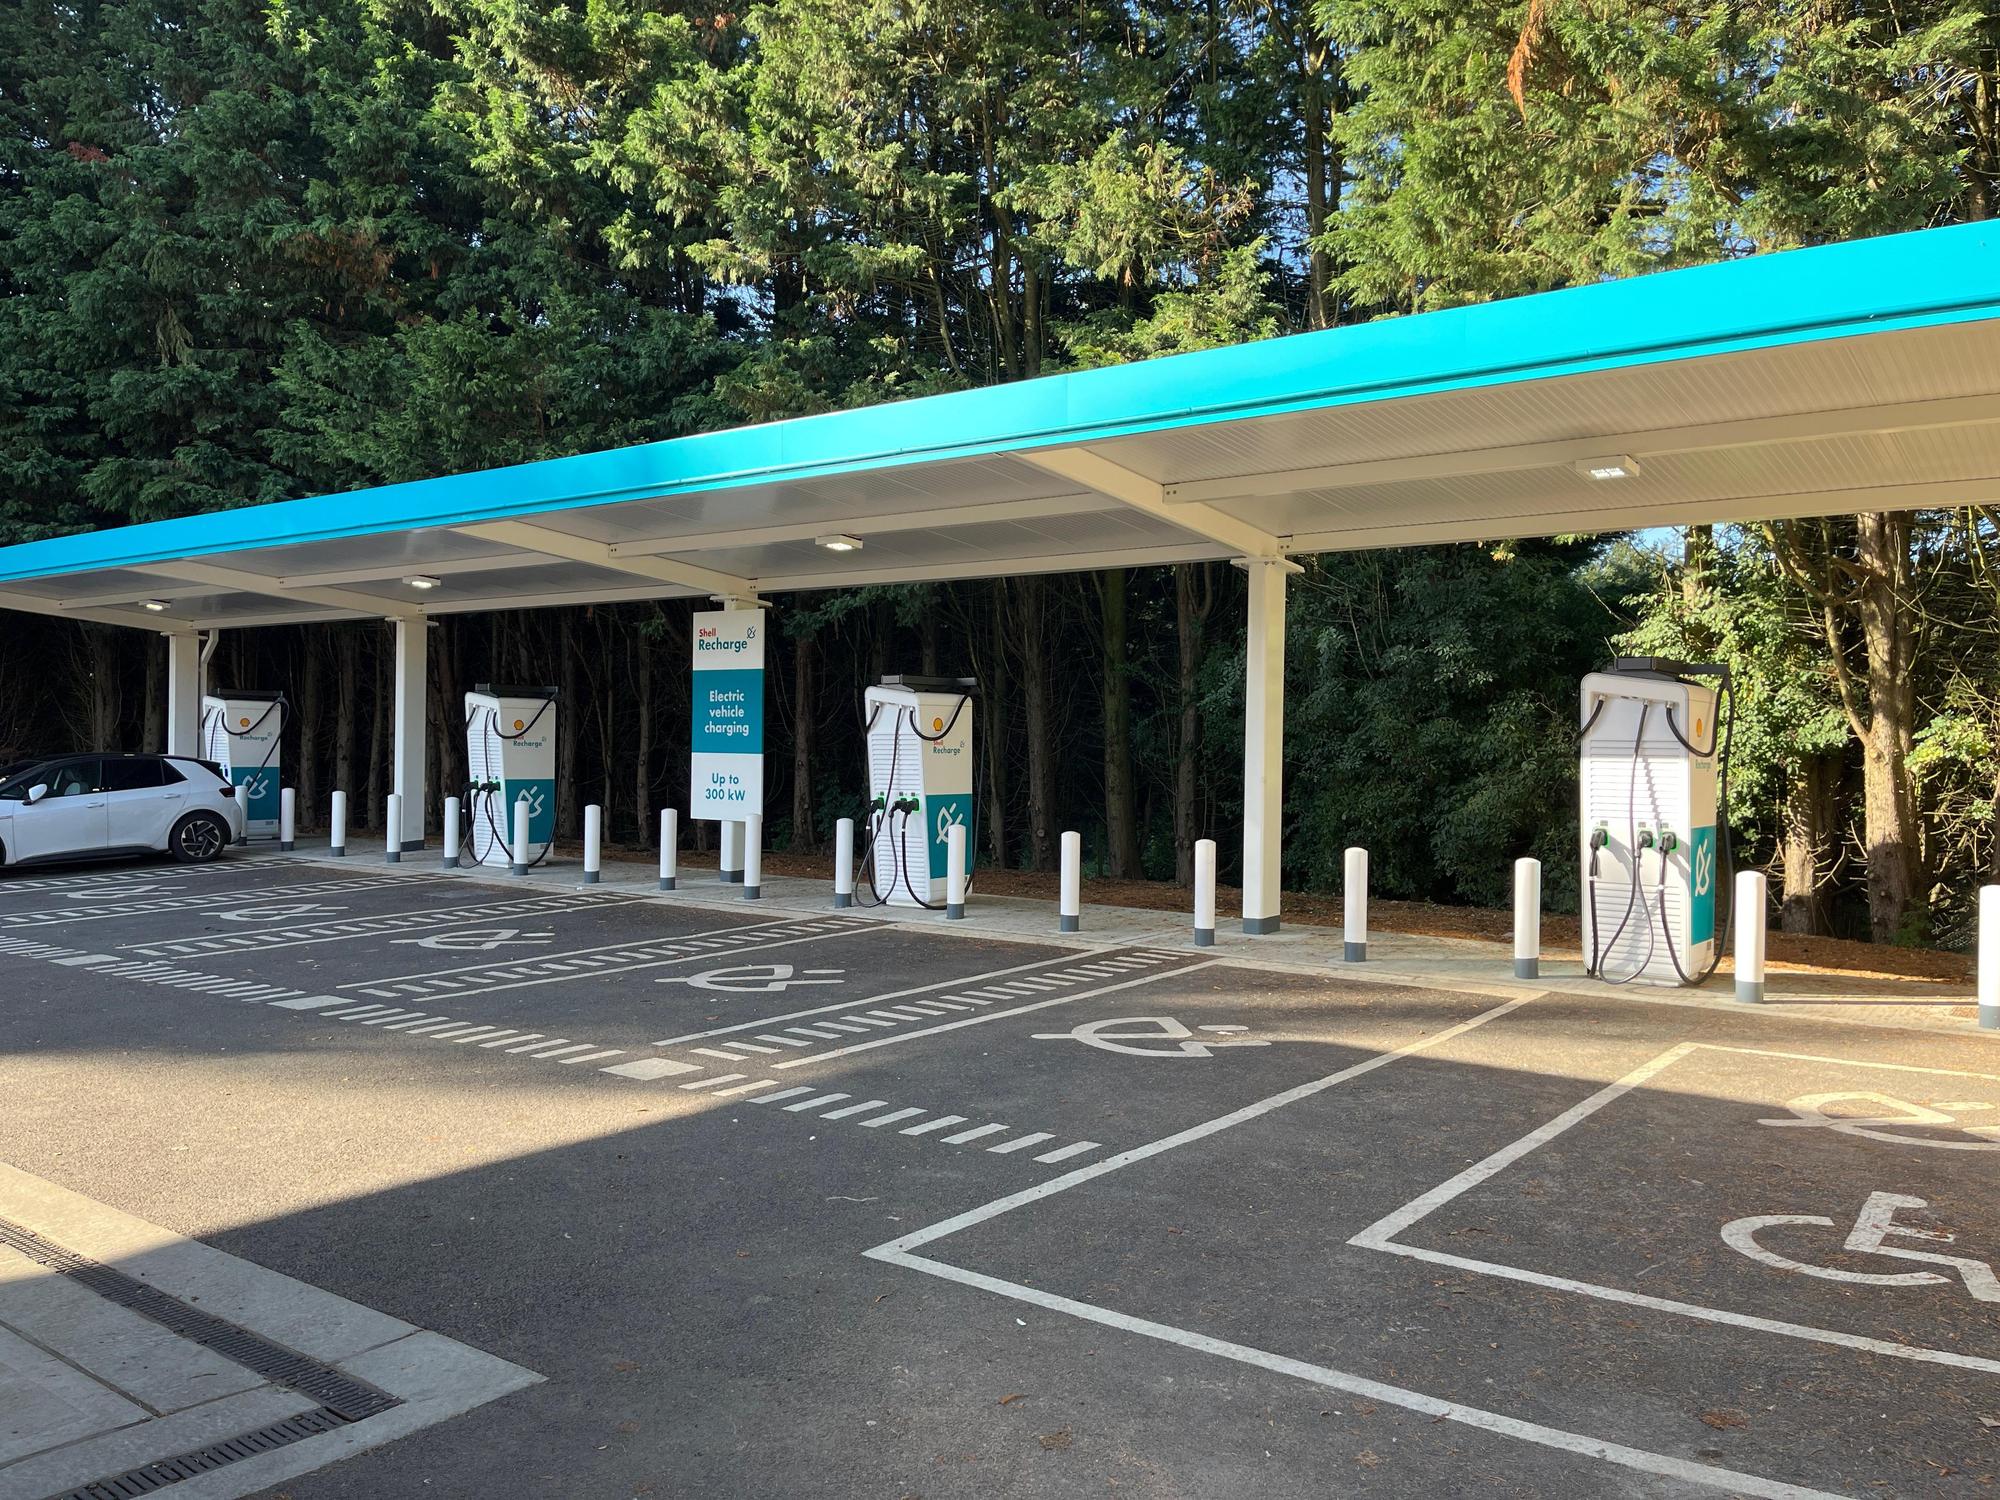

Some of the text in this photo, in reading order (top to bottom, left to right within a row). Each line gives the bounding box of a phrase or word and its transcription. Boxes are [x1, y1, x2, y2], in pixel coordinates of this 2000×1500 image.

[699, 628, 716, 637] Shell
[698, 637, 747, 653] Recharge
[709, 690, 745, 702] Electric
[709, 705, 745, 718] vehicle
[704, 721, 749, 736] charging
[513, 740, 543, 748] Recharge
[933, 746, 960, 755] Recharge
[711, 772, 739, 787] Up to
[705, 788, 746, 801] 300 kW
